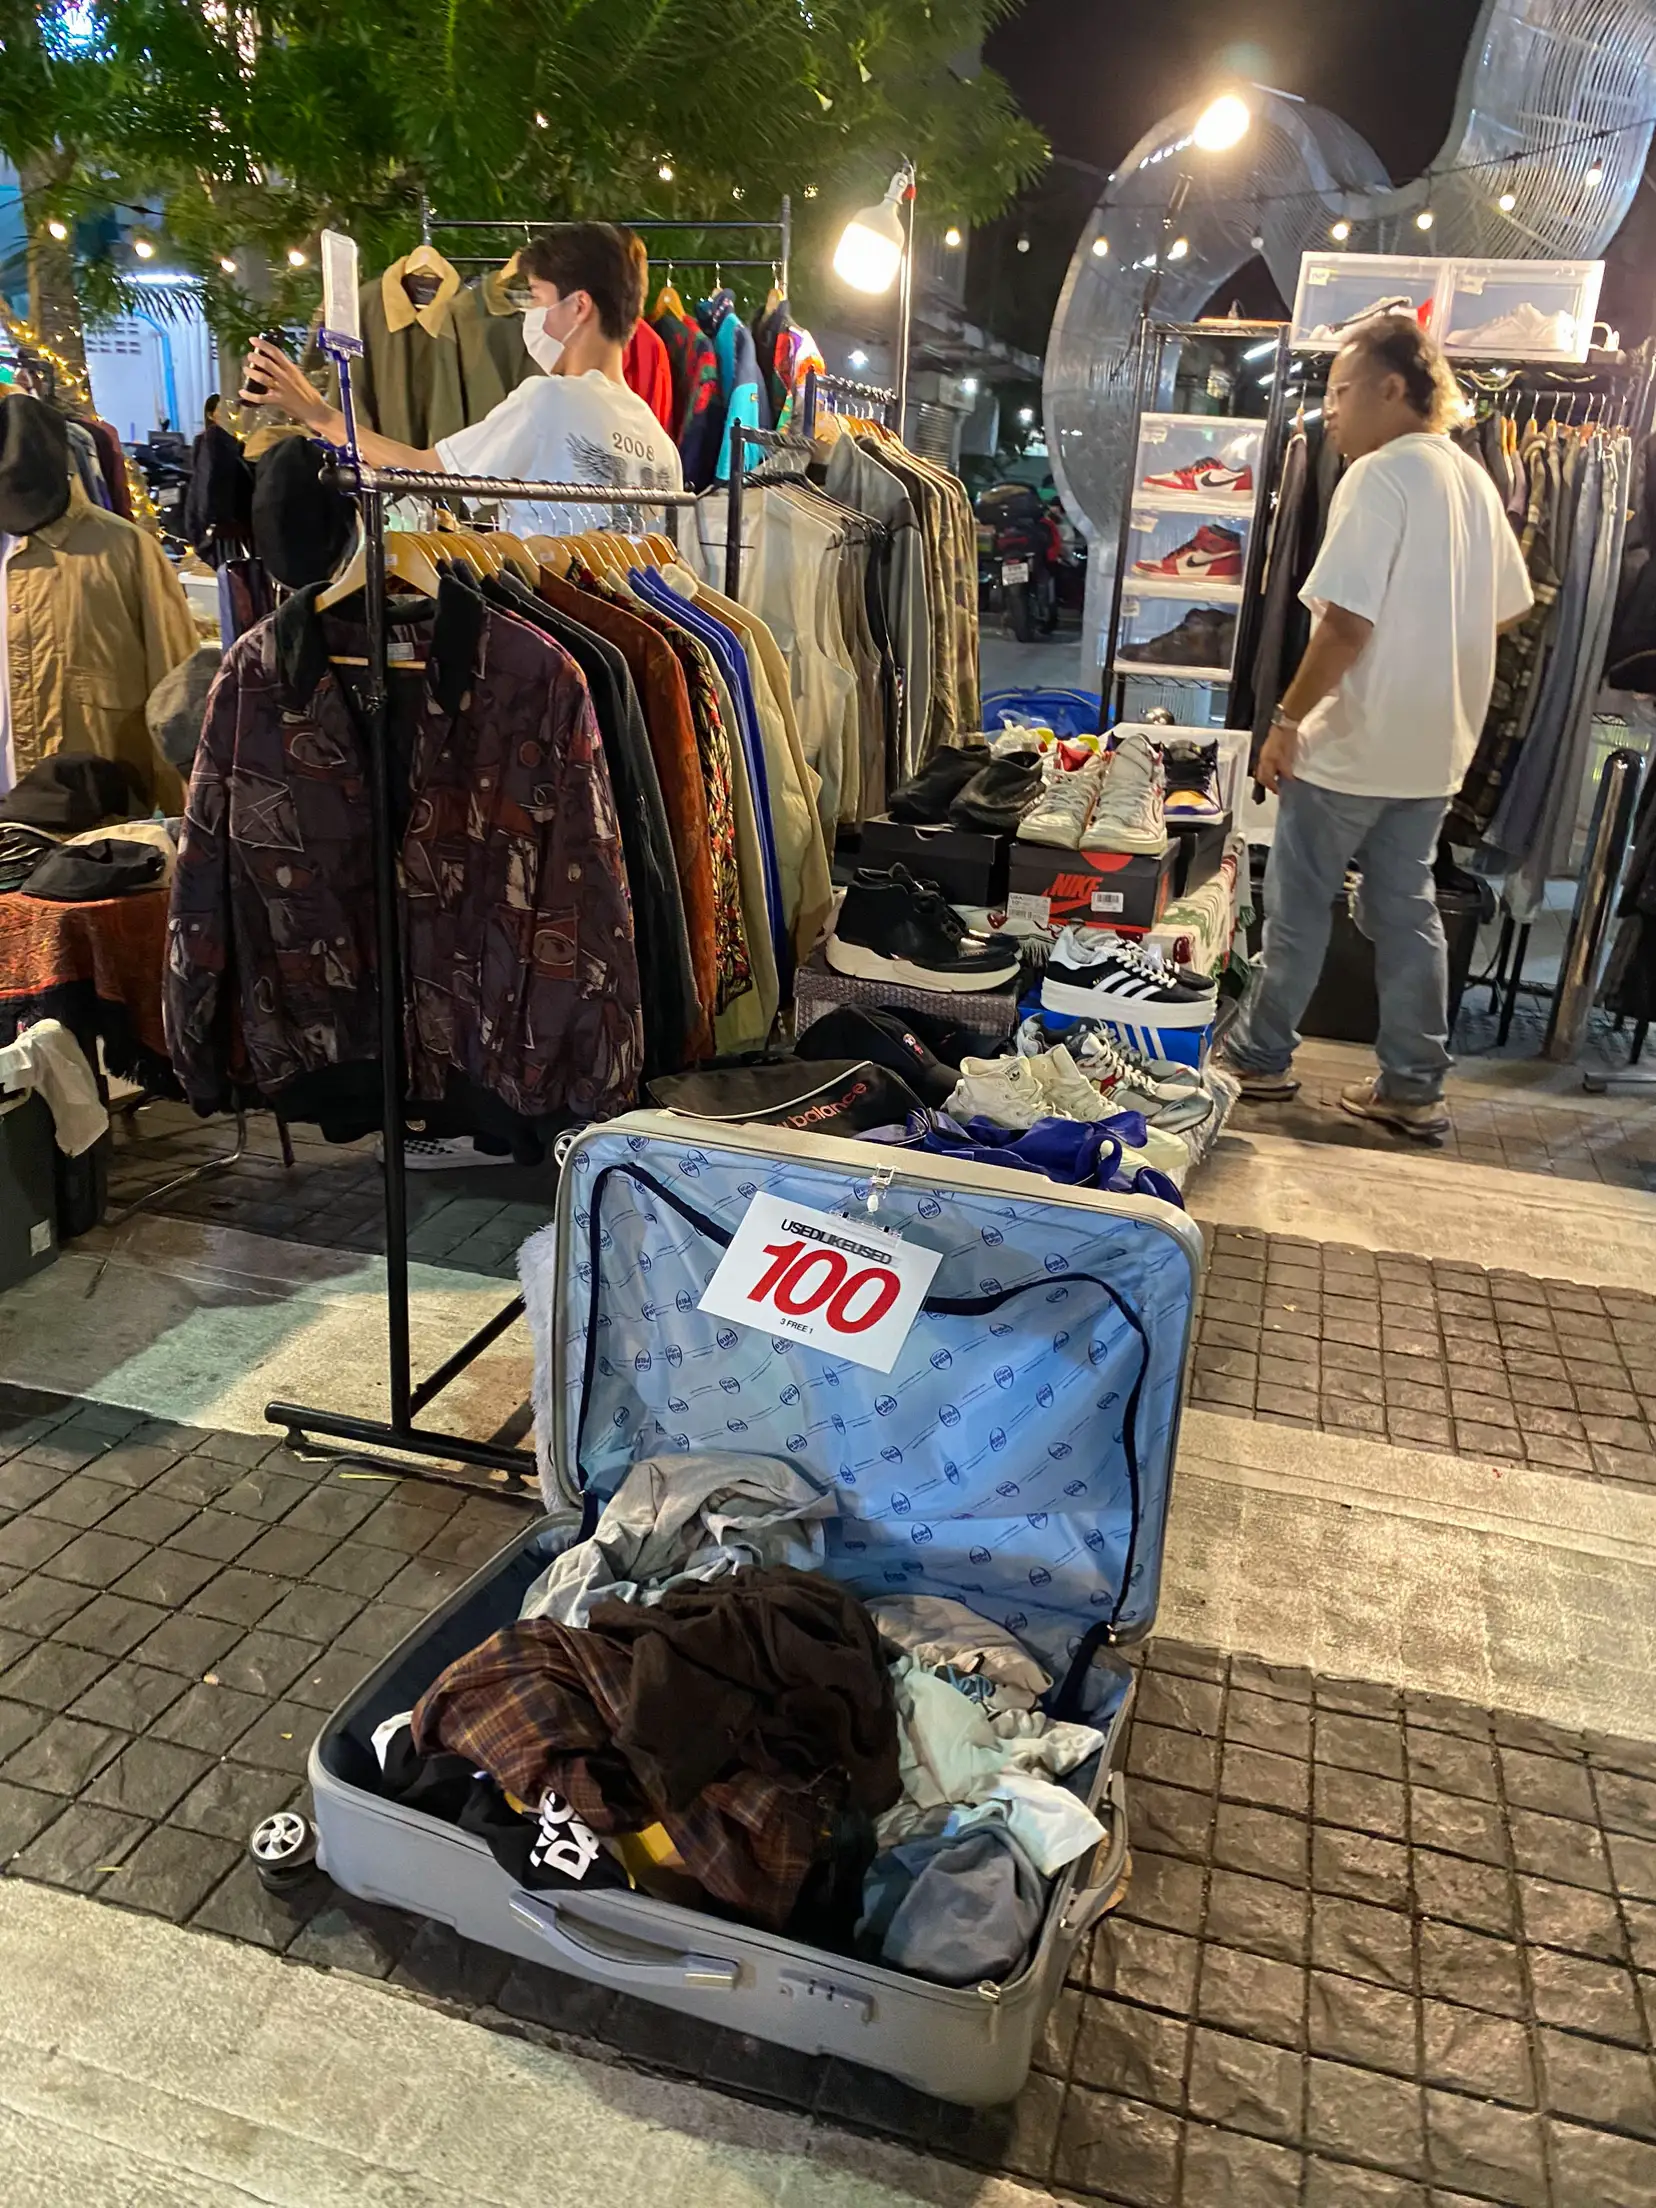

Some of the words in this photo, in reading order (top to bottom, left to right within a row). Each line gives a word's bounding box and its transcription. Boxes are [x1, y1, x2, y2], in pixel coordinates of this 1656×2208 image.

[612, 432, 655, 462] 2008
[1048, 873, 1104, 899] NIKE
[788, 1082, 867, 1128] balance
[780, 1218, 893, 1265] USEDLIKEUSED
[747, 1240, 901, 1334] 100
[779, 1317, 787, 1326] 3
[787, 1320, 808, 1333] FREE
